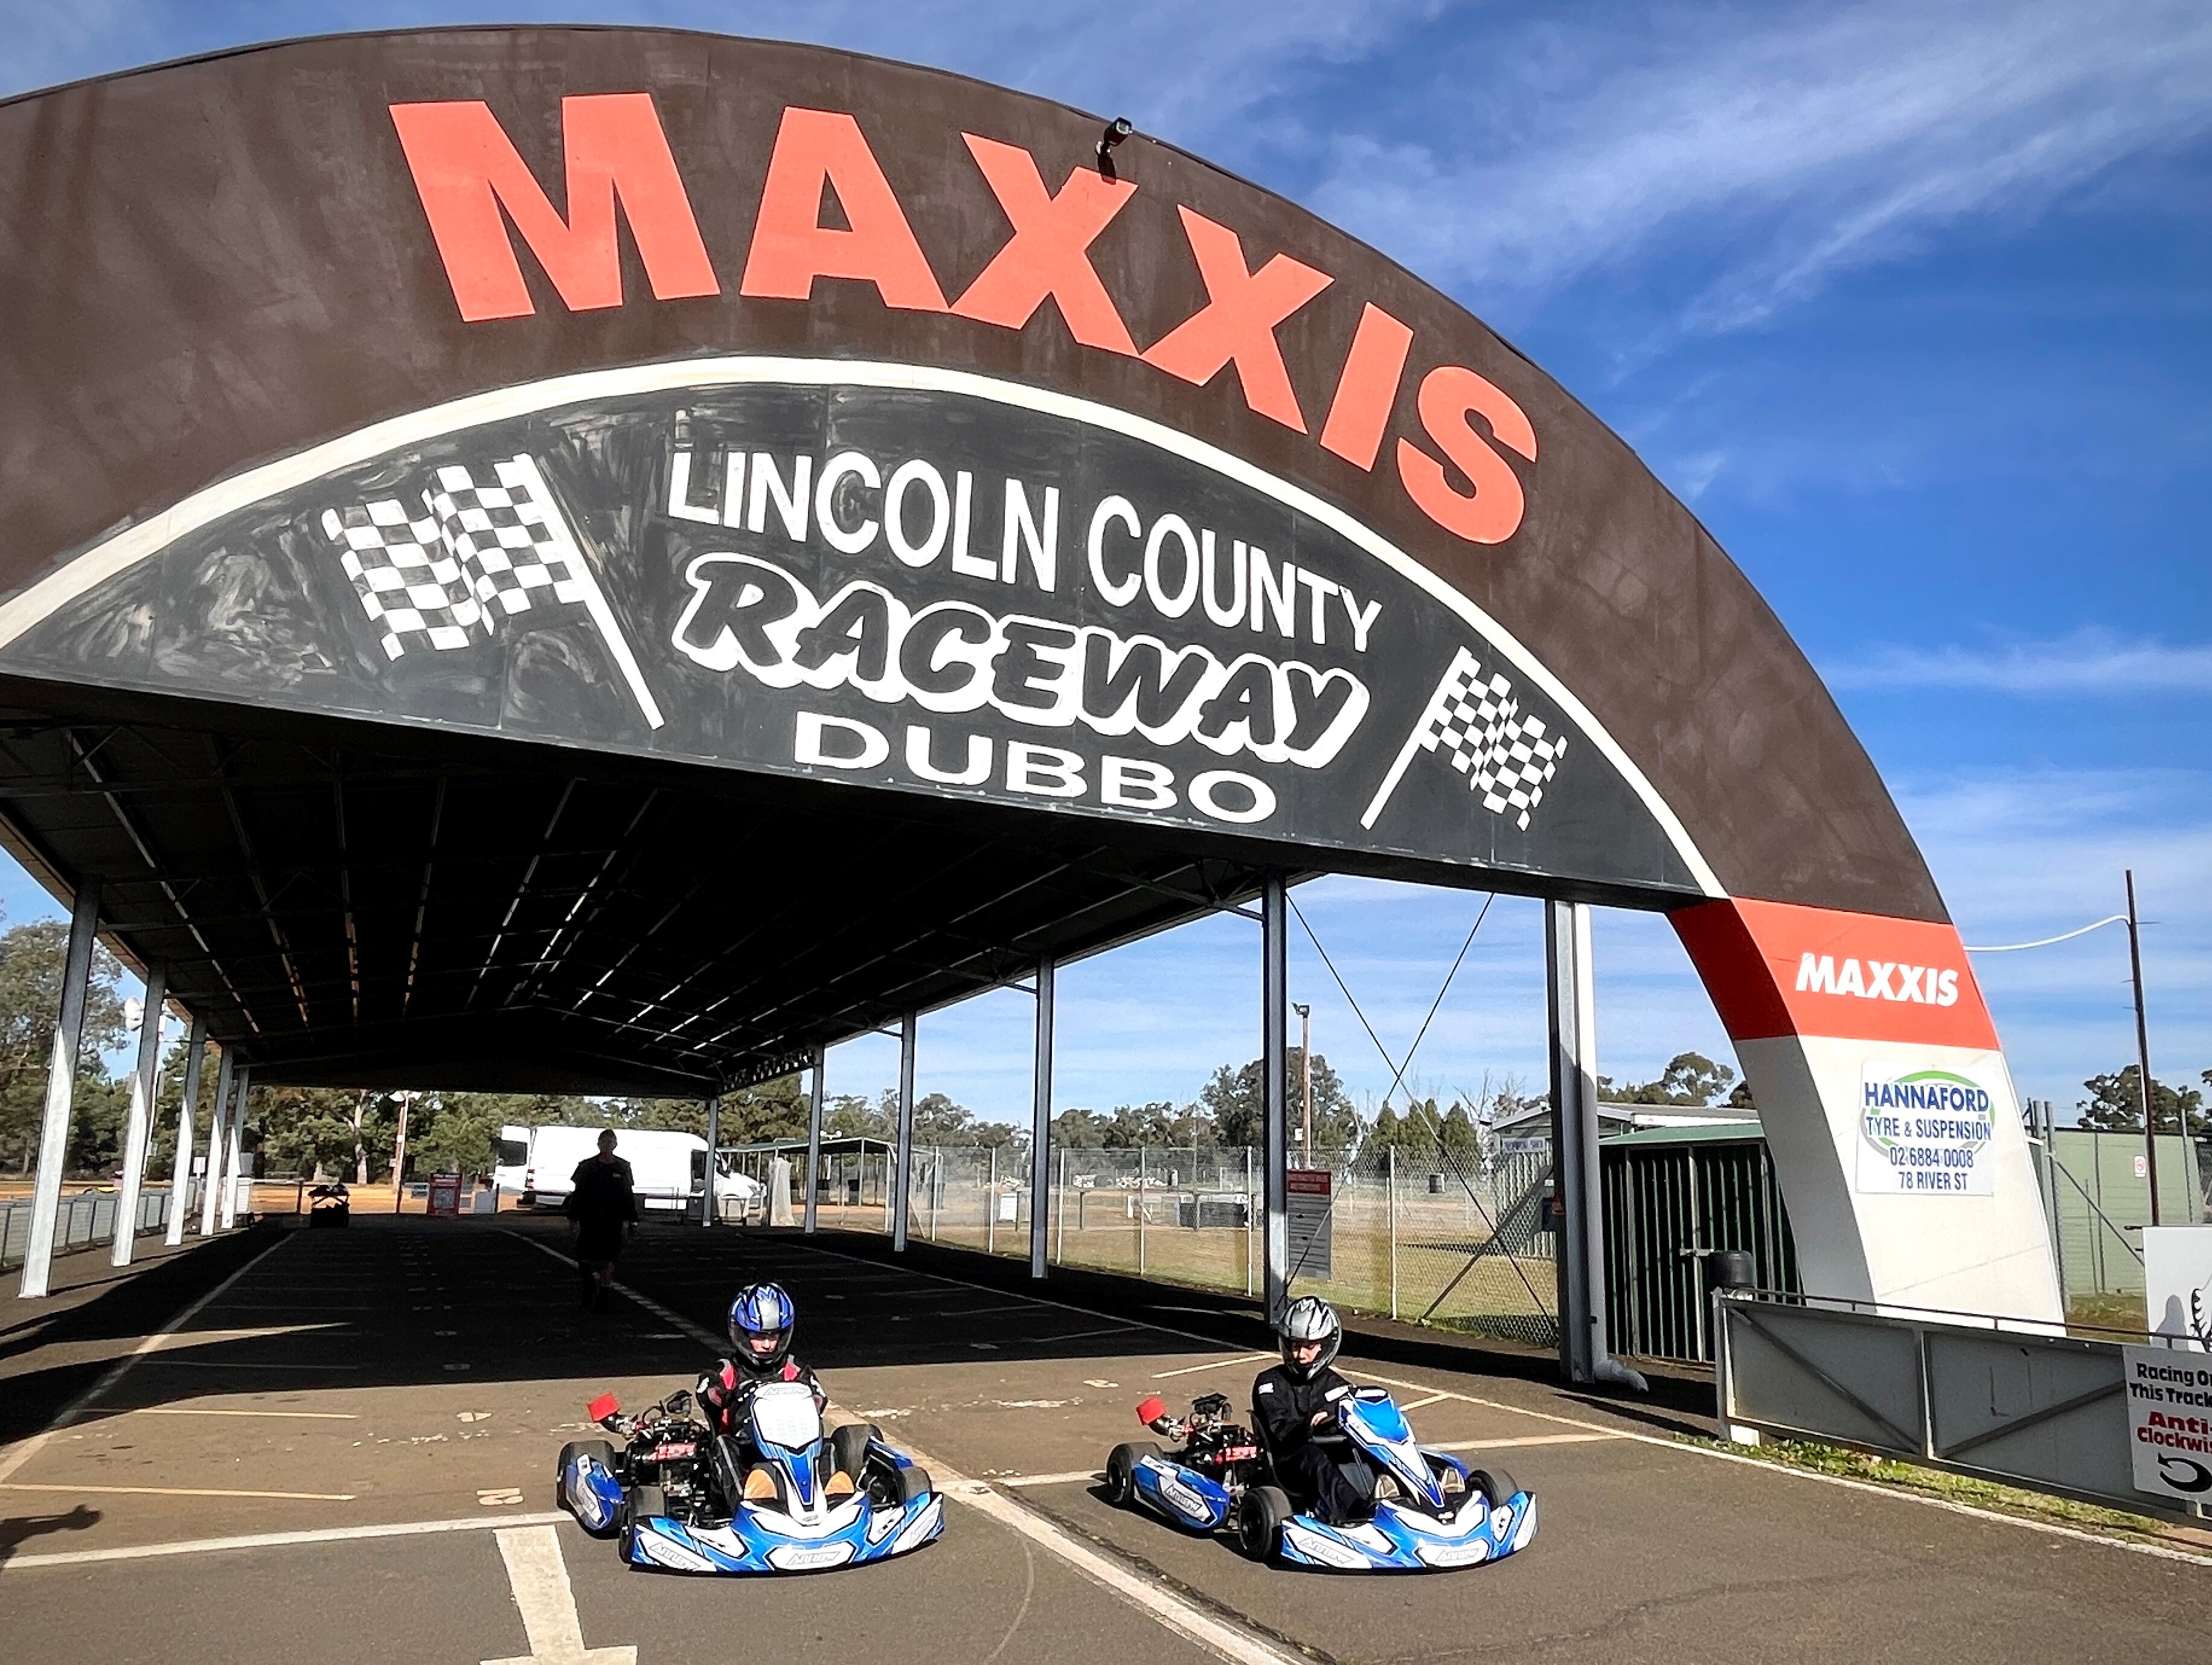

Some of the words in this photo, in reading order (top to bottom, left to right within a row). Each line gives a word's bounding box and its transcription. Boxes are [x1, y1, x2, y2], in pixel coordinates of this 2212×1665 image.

[388, 92, 1536, 545] MAXXIS
[668, 451, 1060, 592] LINCOLN
[1088, 495, 1382, 652] COUNTY
[671, 551, 1370, 769] RACEWAY
[795, 711, 1277, 823] DUBBO
[1795, 952, 1958, 1007] MAXXIS
[1865, 1082, 1989, 1112] HANNAFORD
[1866, 1116, 1900, 1137] TYRE
[1904, 1121, 1912, 1137] &
[1916, 1118, 1992, 1140] SUSPENSION
[1898, 1171, 1913, 1189] 78
[1917, 1172, 1951, 1190] RIVER
[1954, 1172, 1967, 1190] ST
[2129, 1382, 2164, 1401] This
[2137, 1362, 2194, 1387] Racing
